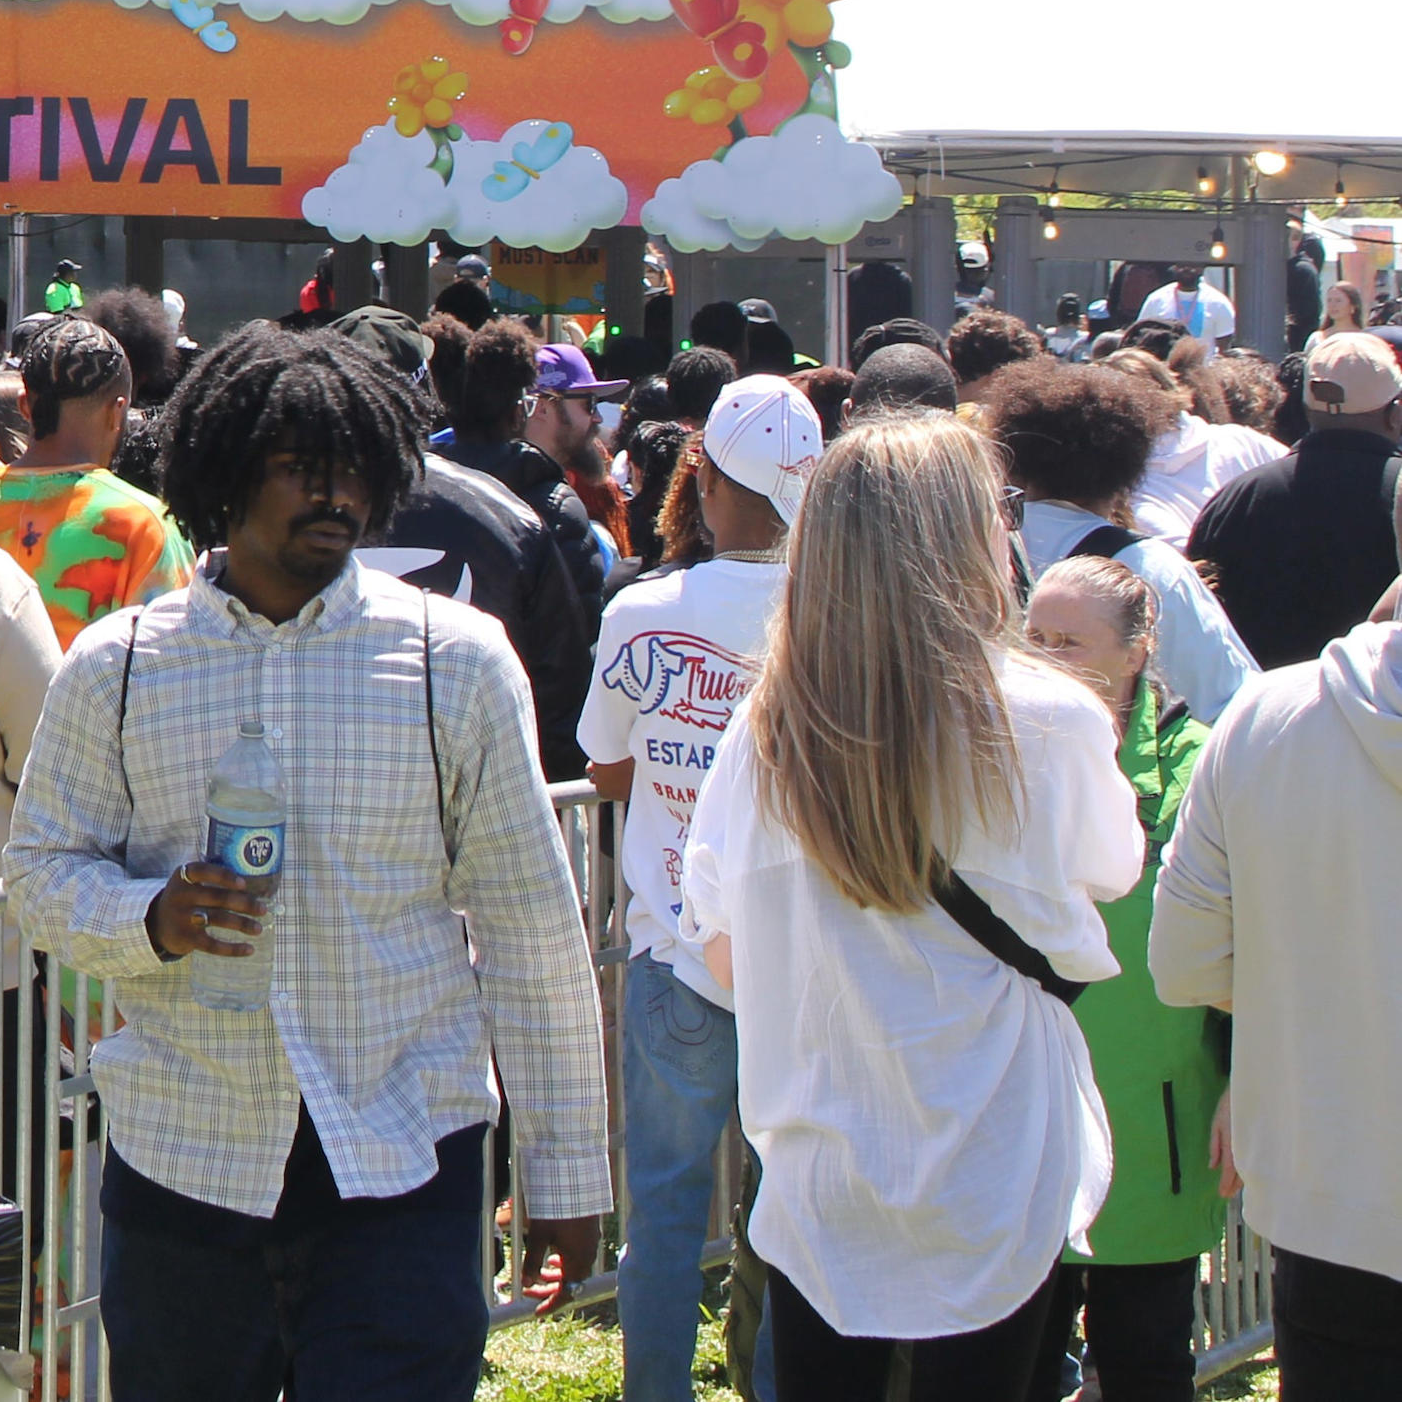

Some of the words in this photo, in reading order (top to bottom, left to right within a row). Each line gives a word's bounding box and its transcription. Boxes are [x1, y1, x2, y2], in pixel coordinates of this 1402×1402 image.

[499, 247, 543, 265] MUST
[646, 739, 715, 769] ESTAB
[653, 782, 700, 803] BRAN
[249, 839, 271, 849] Pure
[252, 848, 268, 861] Life
